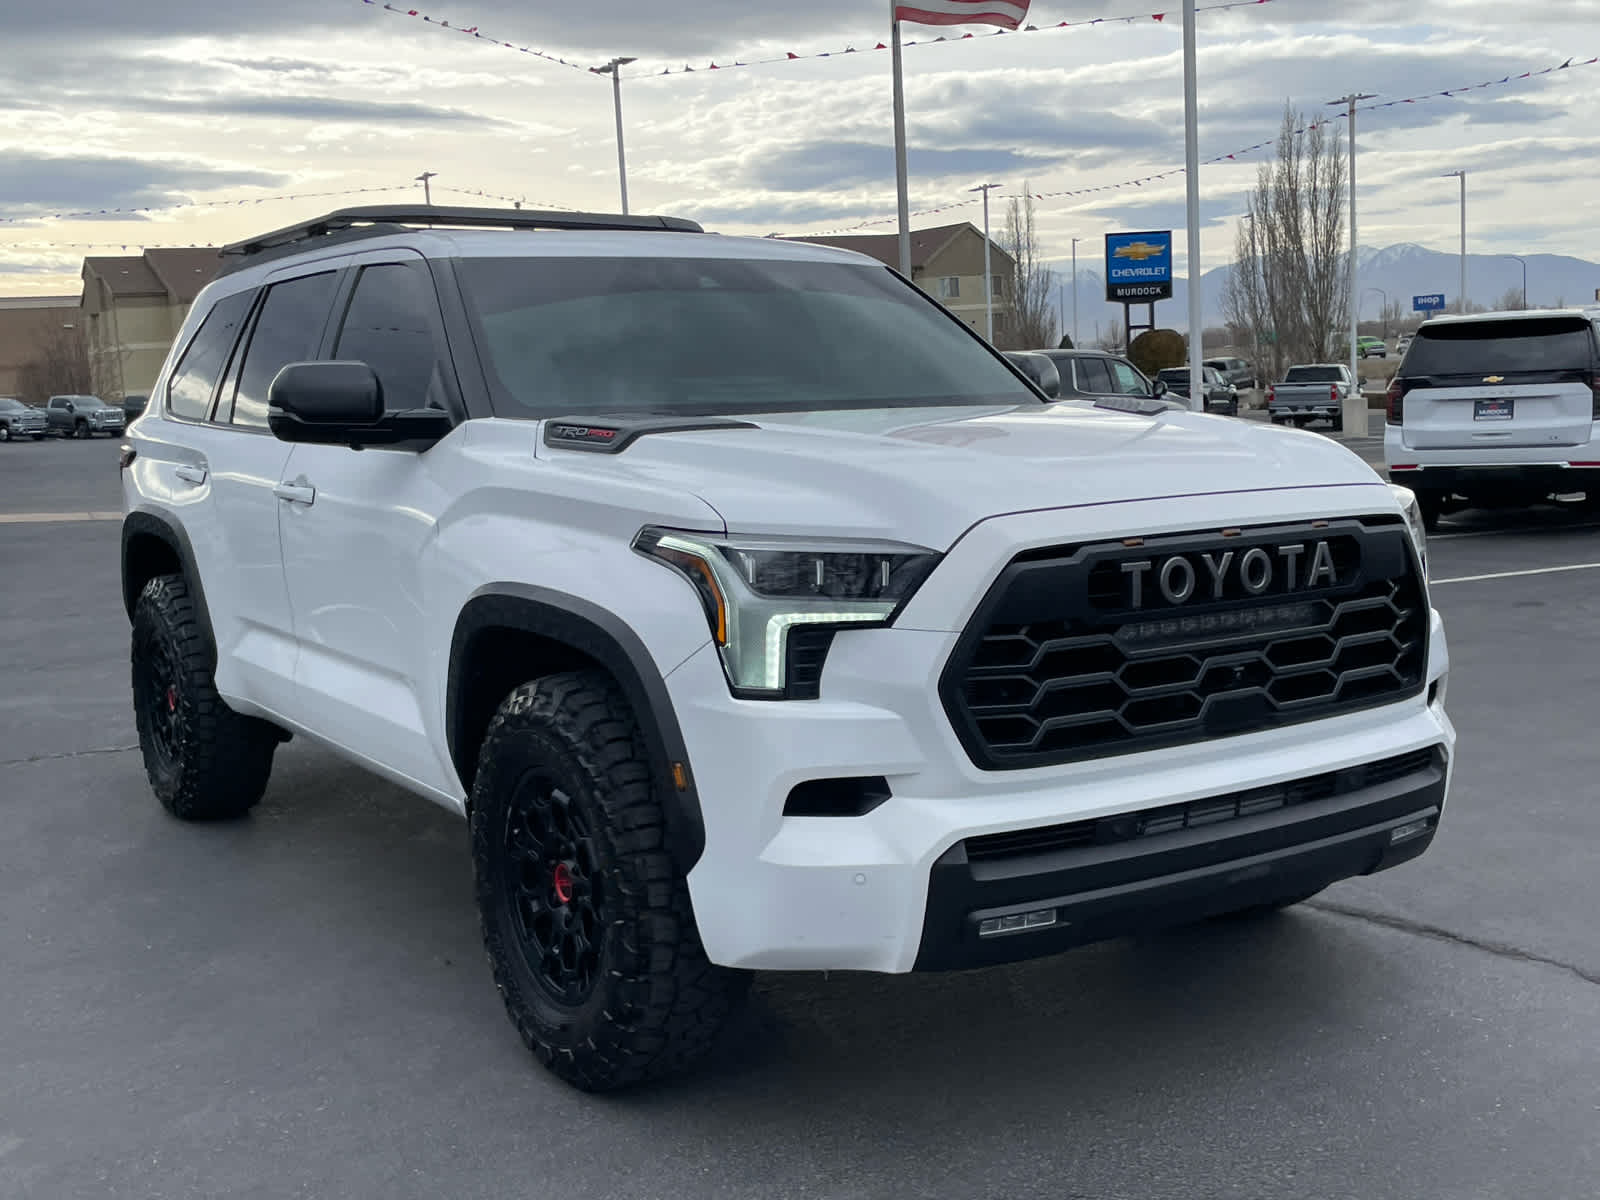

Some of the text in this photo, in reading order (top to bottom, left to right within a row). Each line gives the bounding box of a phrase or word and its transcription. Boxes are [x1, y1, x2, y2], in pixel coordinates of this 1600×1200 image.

[1111, 266, 1167, 277] CHEVROLET
[1117, 287, 1162, 296] MURDOCK
[556, 426, 617, 438] TRD PRO
[1120, 541, 1337, 609] TOYOTA
